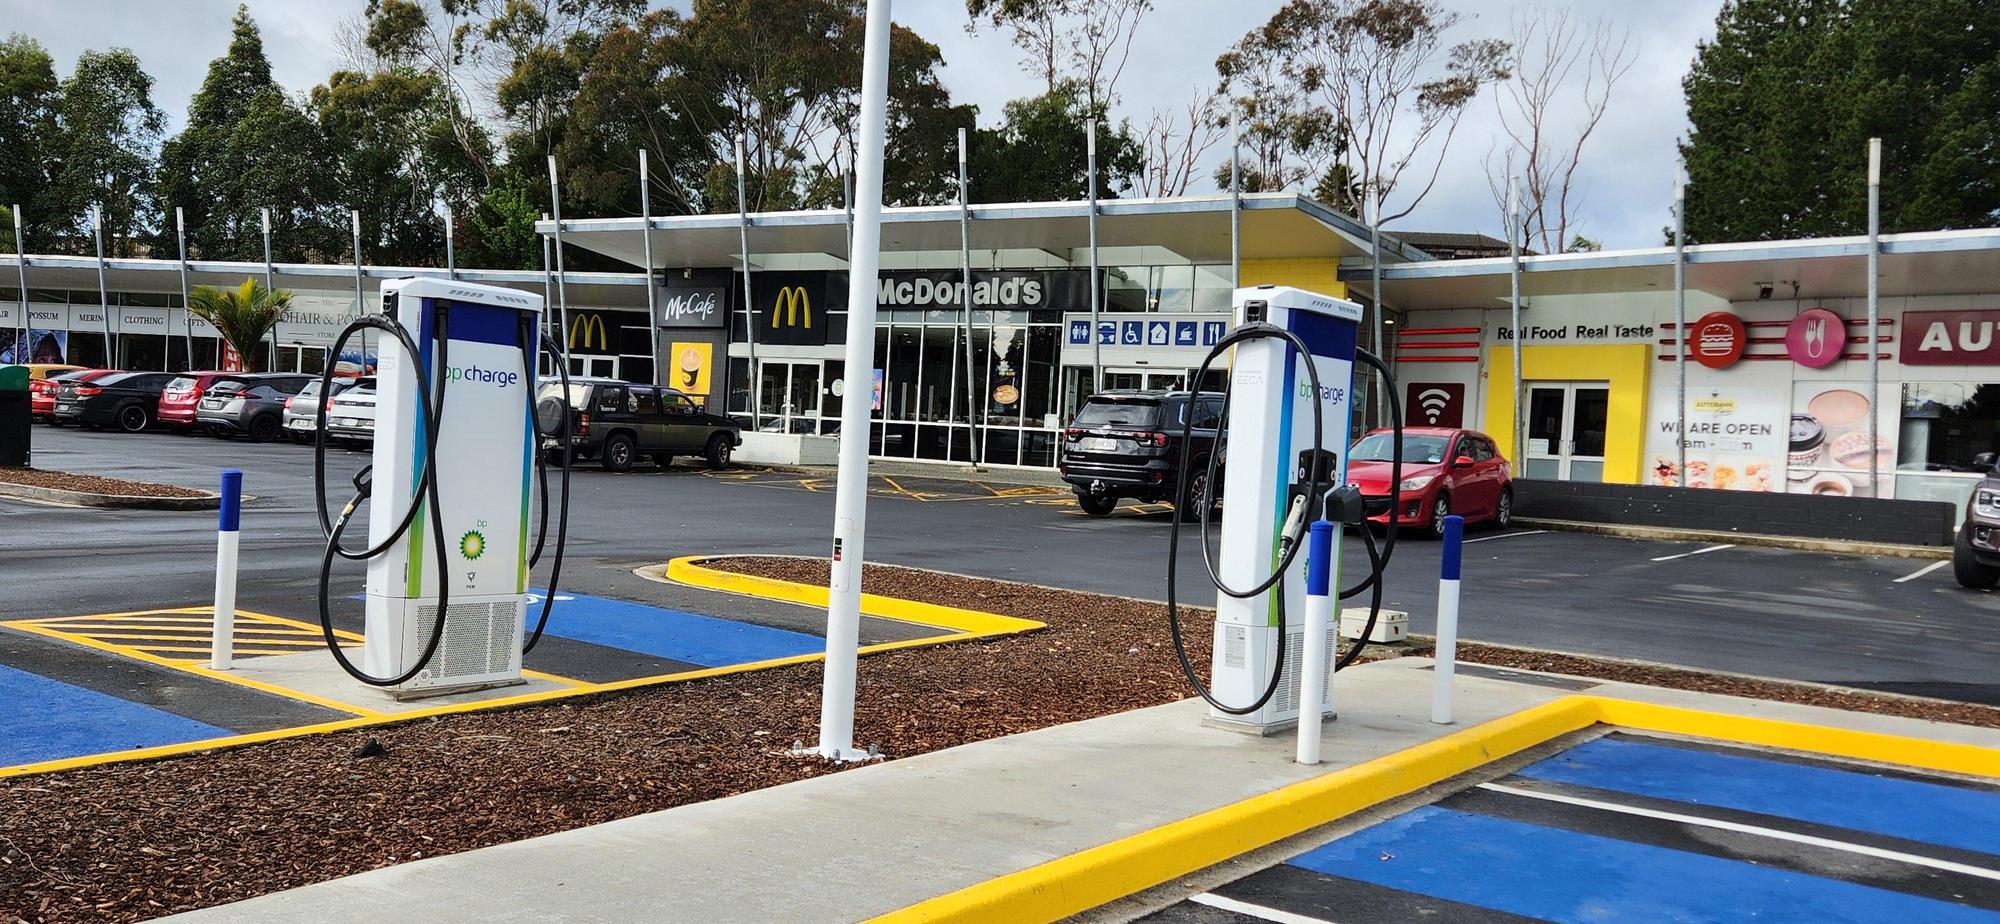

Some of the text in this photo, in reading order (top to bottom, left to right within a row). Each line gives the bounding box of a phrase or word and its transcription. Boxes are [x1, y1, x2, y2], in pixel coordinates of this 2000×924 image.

[877, 277, 1042, 305] McDonald's
[665, 292, 716, 321] McCafé
[29, 311, 59, 320] POSSUM
[79, 314, 105, 322] MERIN
[124, 315, 164, 325] CLOTHING
[182, 318, 206, 326] FTS
[280, 312, 321, 325] OHAIR
[323, 314, 334, 325] &
[1497, 324, 1654, 340] Rel Food Real Taste
[1918, 321, 2000, 352] AU
[464, 365, 518, 388] charge
[1300, 379, 1344, 405] bp harge
[1689, 422, 1721, 434] ARE
[1726, 423, 1772, 436] OPEN
[477, 518, 488, 528] bp
